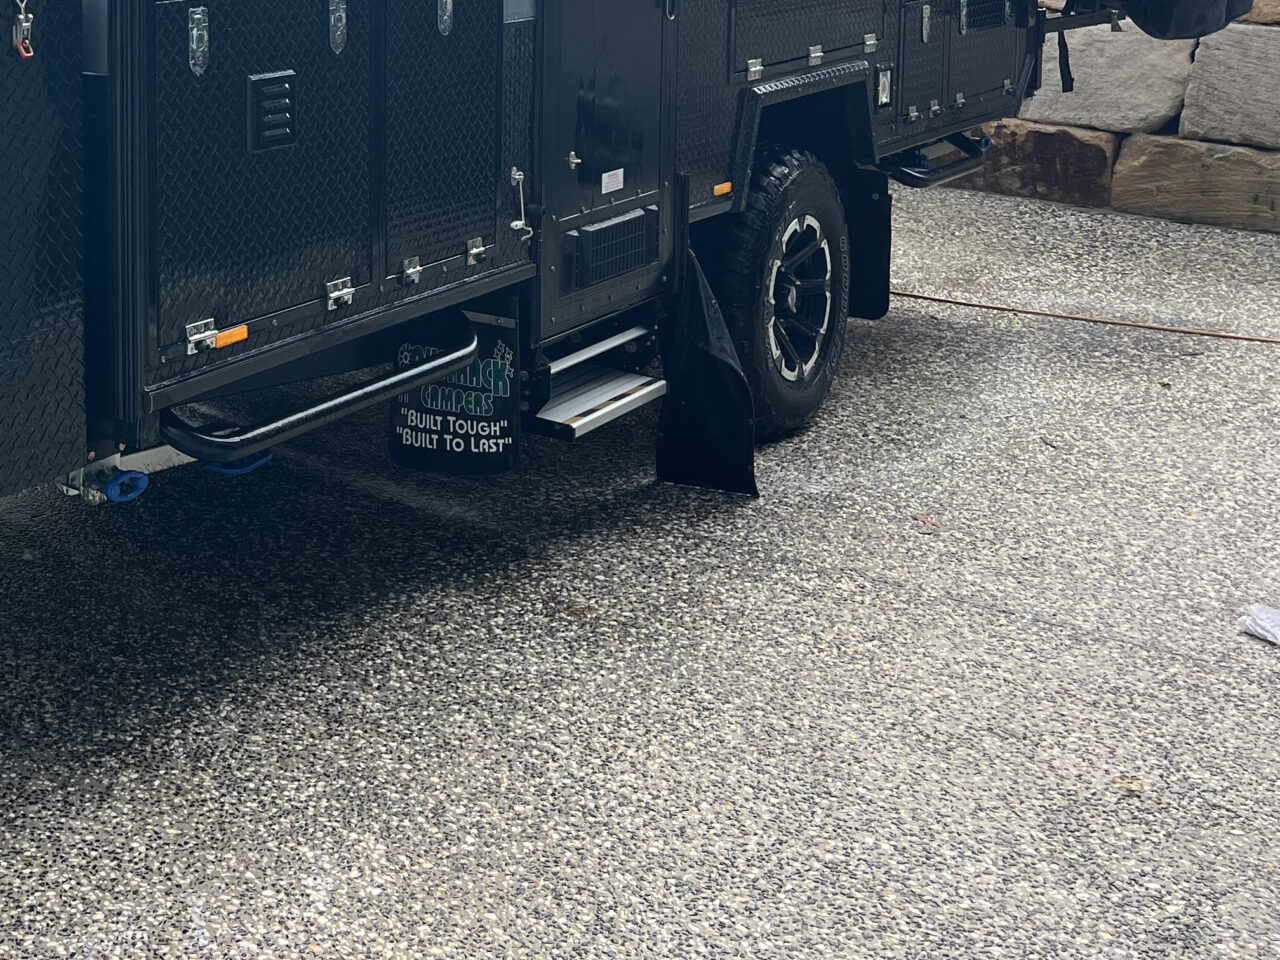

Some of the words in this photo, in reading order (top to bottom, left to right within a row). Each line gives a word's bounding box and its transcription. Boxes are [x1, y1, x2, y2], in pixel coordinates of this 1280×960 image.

[420, 384, 494, 417] CAMPERS
[401, 407, 443, 431] "BUILT
[447, 416, 508, 436] TOUGH"
[396, 426, 439, 450] "BUILT
[443, 435, 465, 452] TO
[471, 436, 513, 453] LAST"
